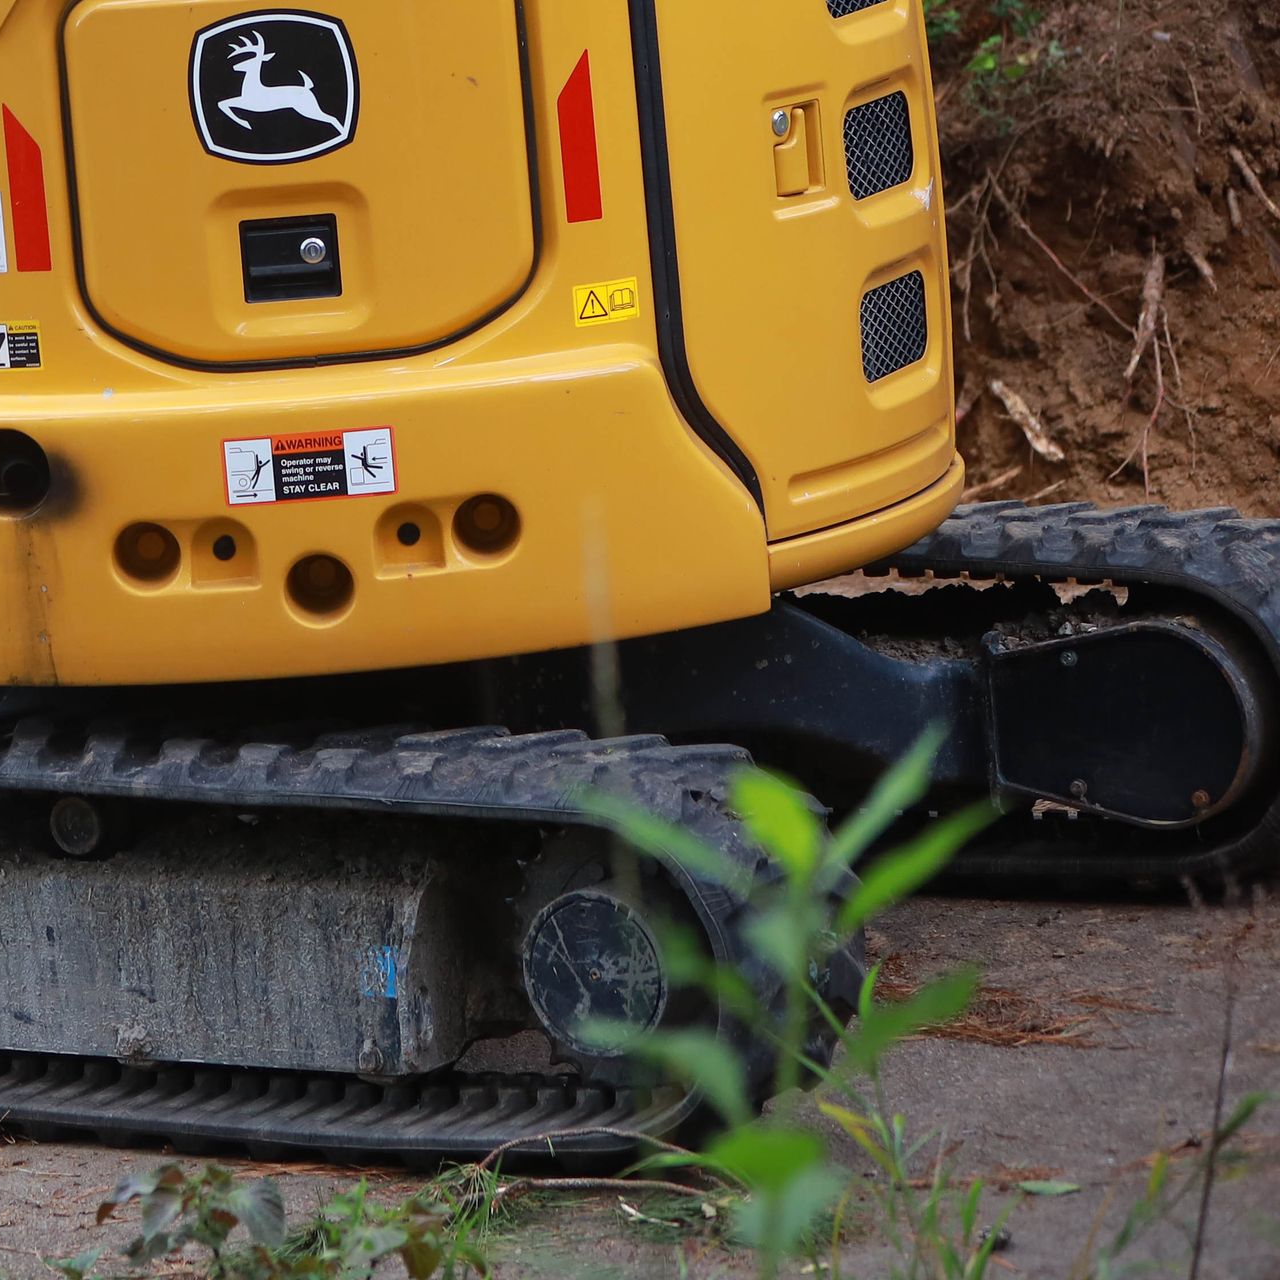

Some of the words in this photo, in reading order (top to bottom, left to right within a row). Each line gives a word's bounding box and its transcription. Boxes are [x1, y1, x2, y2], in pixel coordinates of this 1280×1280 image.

[285, 435, 342, 450] WARNING
[280, 458, 314, 468] Operator
[315, 456, 332, 465] may
[281, 467, 304, 475] swing
[315, 463, 343, 472] reverse
[282, 474, 314, 483] machine
[283, 484, 306, 494] STAY
[308, 481, 340, 492] CLEAR
